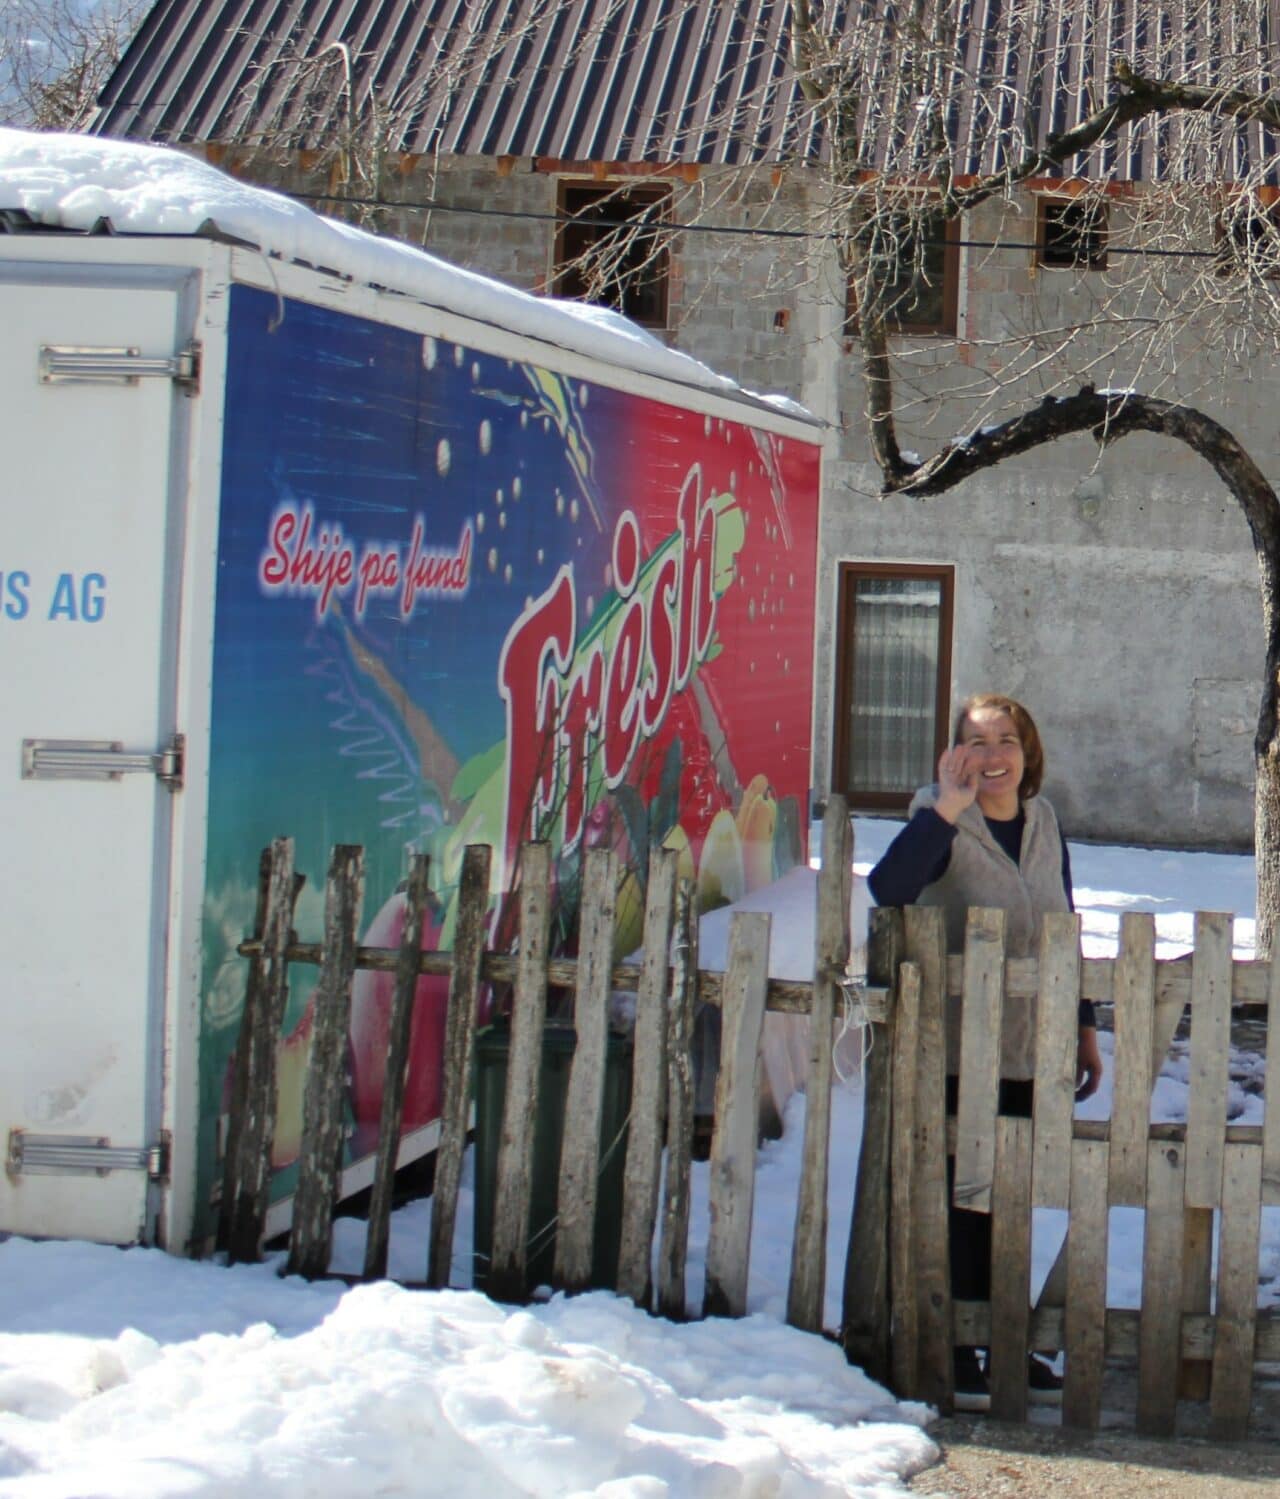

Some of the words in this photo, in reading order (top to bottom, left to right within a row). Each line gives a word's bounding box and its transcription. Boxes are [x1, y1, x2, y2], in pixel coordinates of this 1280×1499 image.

[0, 570, 30, 621] S
[47, 573, 107, 623] AG
[262, 511, 353, 616] Shije
[355, 550, 399, 614] pa
[402, 523, 471, 616] fund
